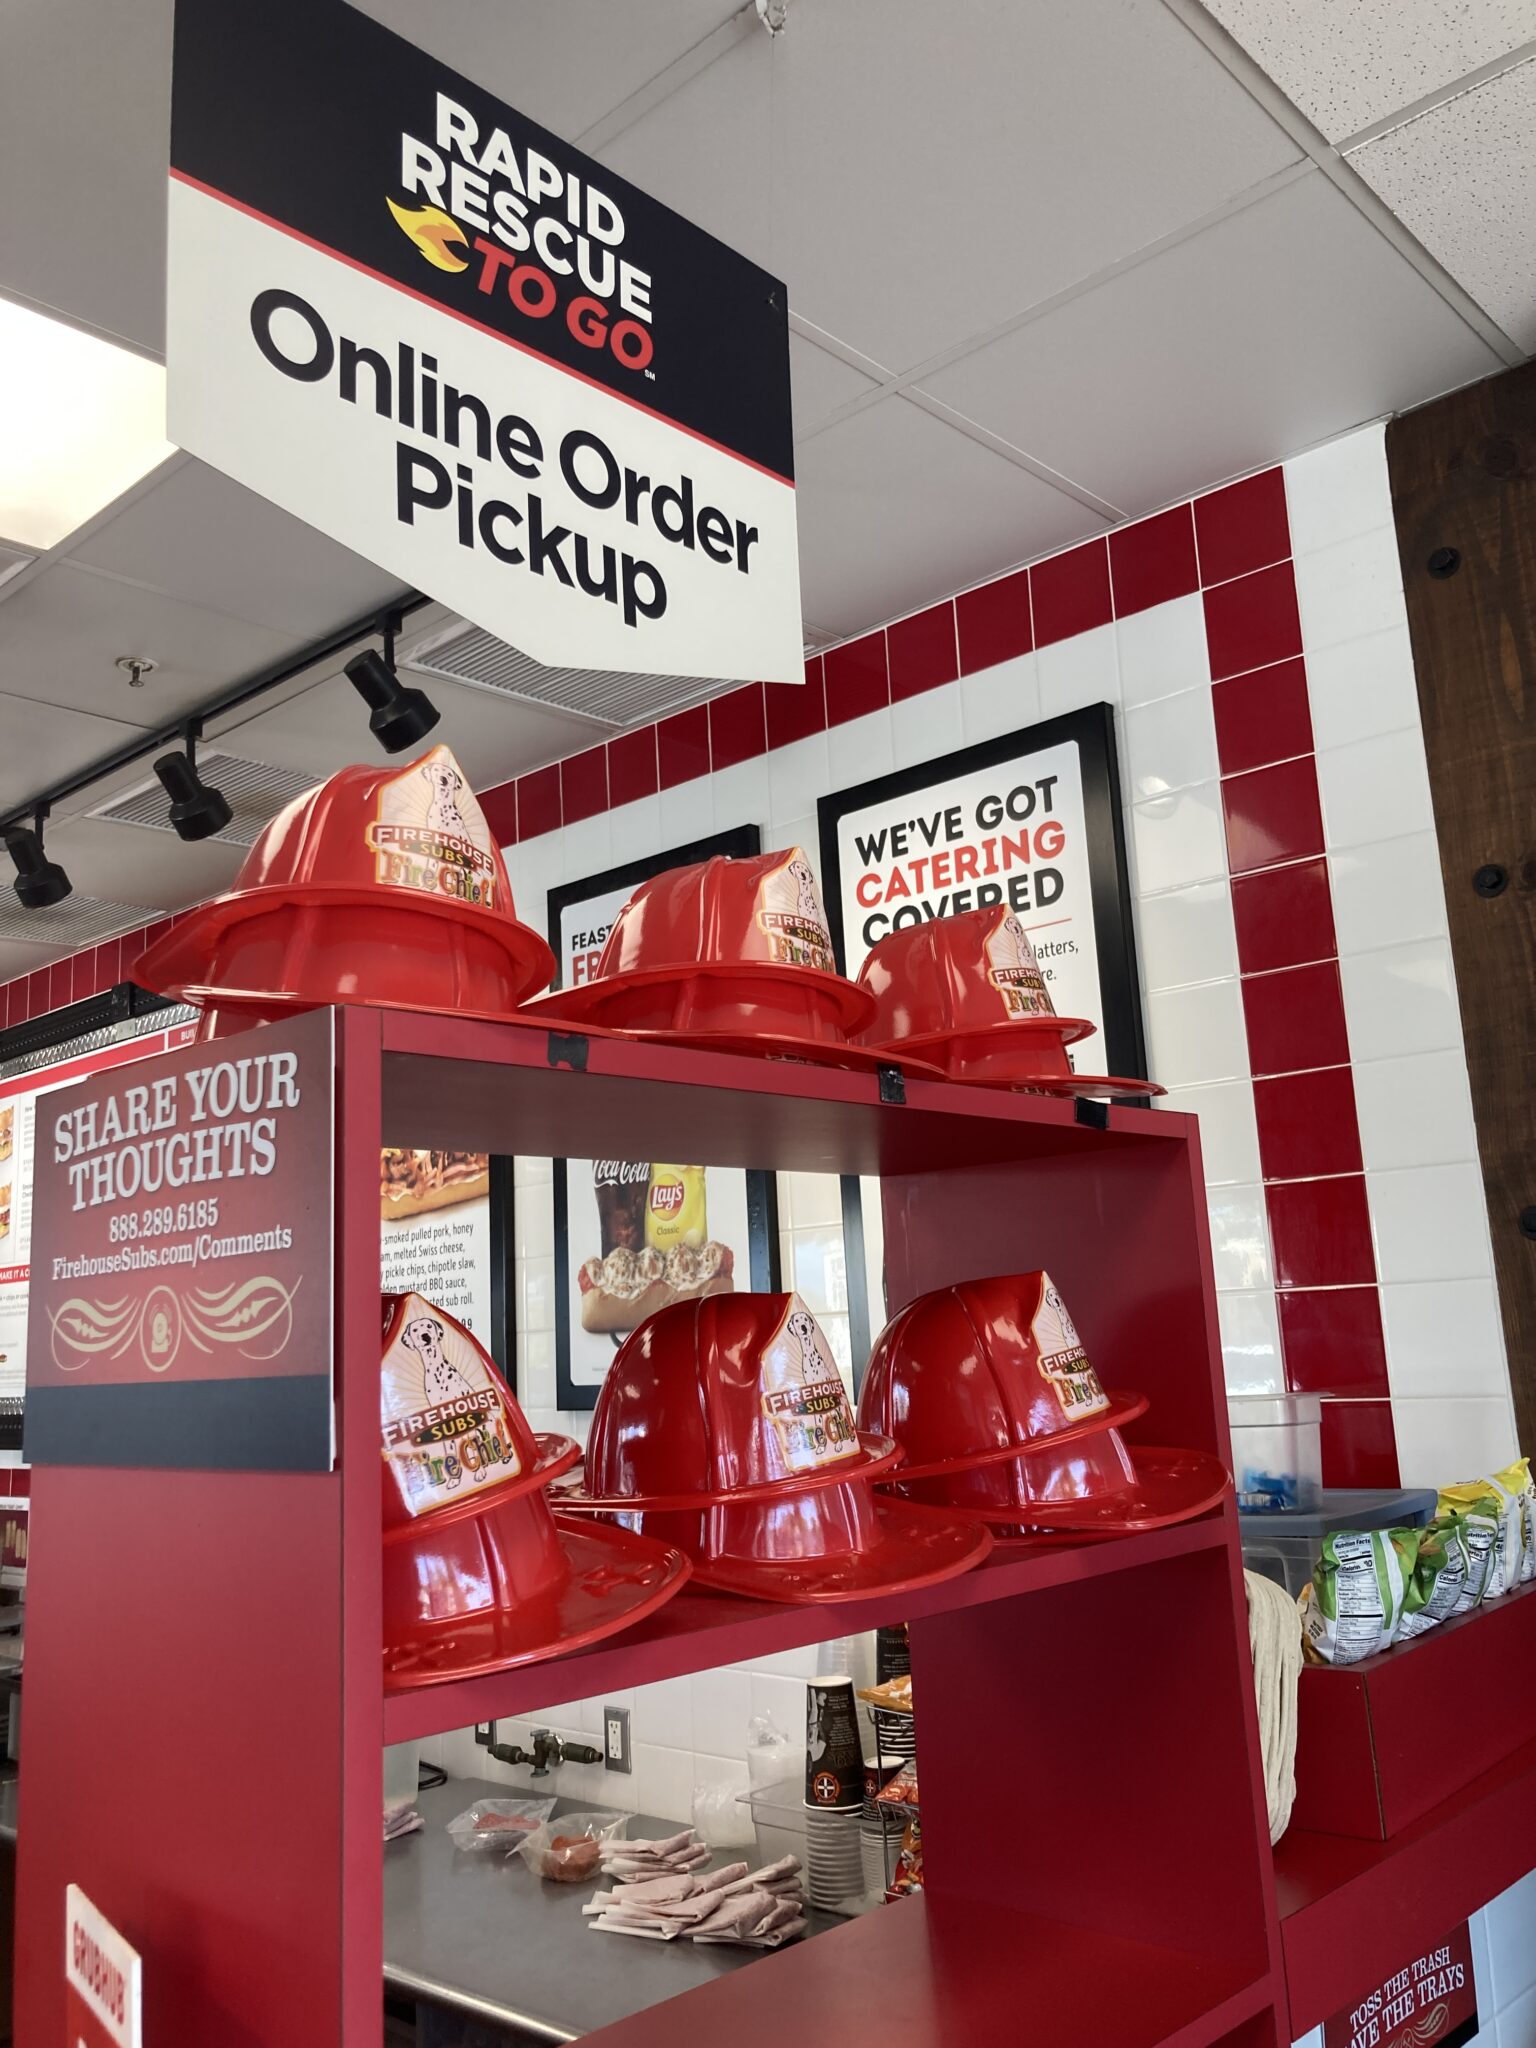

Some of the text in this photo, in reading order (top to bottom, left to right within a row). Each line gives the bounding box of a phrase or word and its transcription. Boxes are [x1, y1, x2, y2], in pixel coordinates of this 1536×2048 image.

[434, 90, 626, 248] RAPID
[400, 131, 653, 324] RESCUE
[474, 238, 558, 319] TO
[566, 295, 654, 371] GO
[249, 287, 759, 575] Online Order
[396, 440, 668, 628] Pickup
[855, 775, 1058, 867] WE'VE GOT
[376, 827, 494, 876] FIREHOUSE
[420, 843, 464, 865] SUBS
[856, 820, 1066, 908] CATERING
[55, 1076, 177, 1163] SHARE
[185, 1052, 301, 1123] YOUR
[69, 1118, 277, 1212] THOUGHTS
[109, 1198, 219, 1243] 888.289.6185
[411, 1227, 432, 1244] pulled
[433, 1224, 451, 1241] pork,
[452, 1222, 474, 1236] honey
[656, 1225, 680, 1236] Classic
[52, 1224, 293, 1281] FirehouseSubs.com/Comments
[385, 1265, 405, 1281] pickle
[406, 1263, 427, 1278] chips,
[427, 1258, 457, 1275] chipotle
[458, 1256, 476, 1269] slaw,
[393, 1246, 417, 1260] melted
[418, 1244, 438, 1257] Swiss
[439, 1242, 466, 1254] cheese,
[398, 1280, 428, 1293] mustard
[429, 1277, 444, 1290] BBQ
[445, 1278, 468, 1289] sauce,
[445, 1294, 459, 1306] sub
[460, 1292, 474, 1304] roll.
[381, 1390, 500, 1451] FIREHOUSE
[431, 1414, 476, 1440] SUBS
[806, 1396, 836, 1413] SUBS
[1350, 1946, 1451, 2033] TOSS THE TRASH
[1382, 1989, 1415, 2033] THE
[1417, 1963, 1465, 2007] TRAYS
